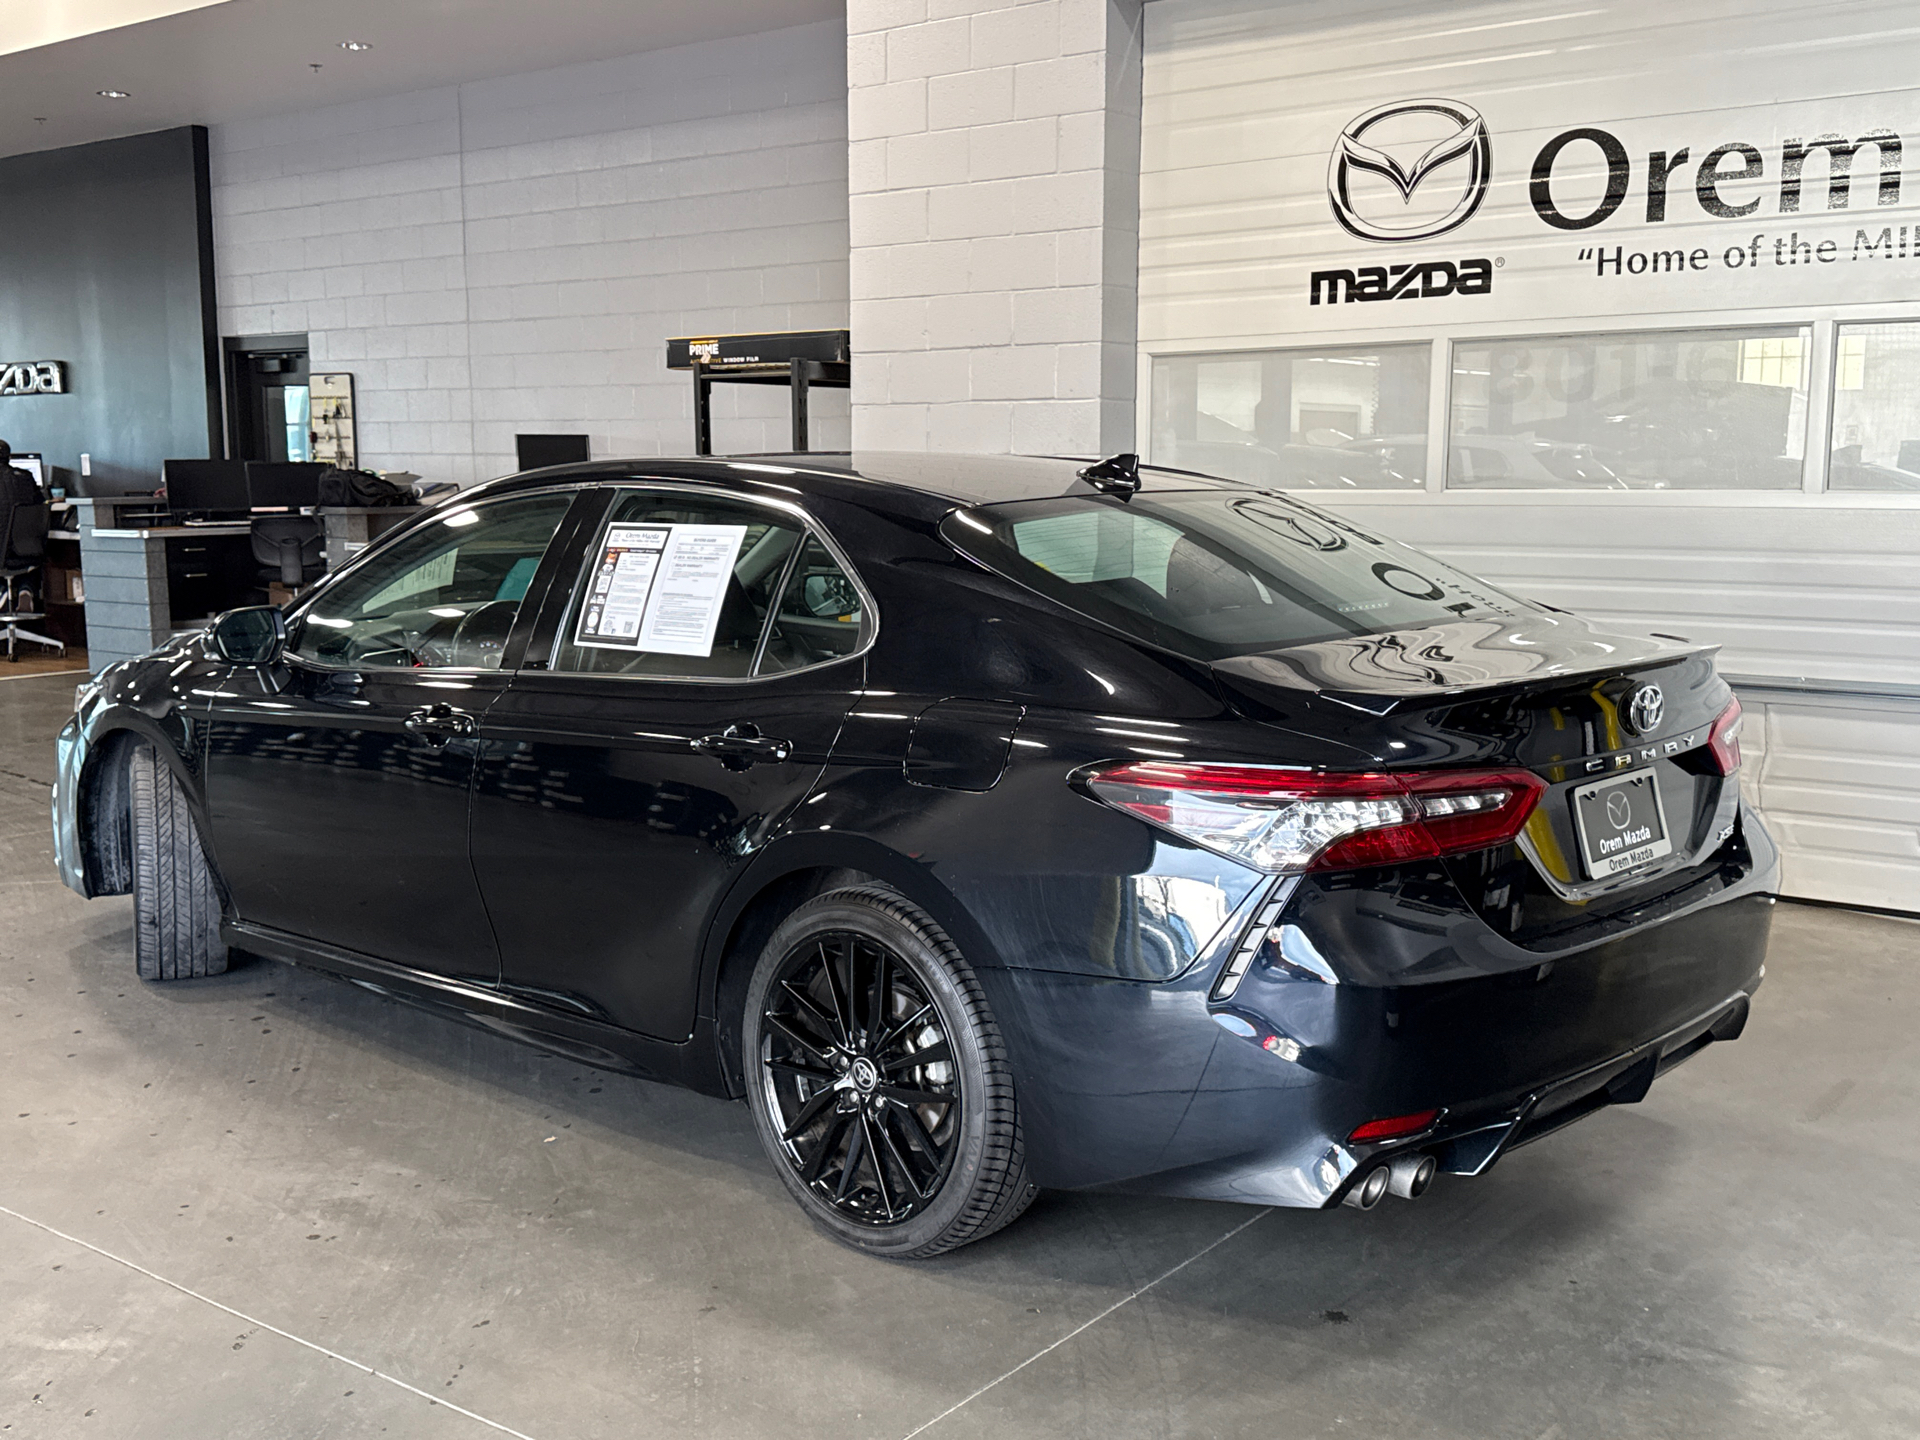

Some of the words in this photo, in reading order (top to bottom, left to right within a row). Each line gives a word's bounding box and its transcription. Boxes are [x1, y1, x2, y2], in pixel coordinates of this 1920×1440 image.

[1528, 127, 1903, 231] Orem
[1723, 234, 1764, 268] of
[1774, 232, 1837, 265] the
[1310, 258, 1492, 306] mazda
[689, 343, 719, 355] PRIME
[1585, 735, 1695, 772] CAMRY
[1600, 836, 1623, 854] Orem
[1623, 825, 1651, 846] Mazda
[1609, 857, 1630, 871] Orem
[1630, 847, 1654, 864] Mazda
